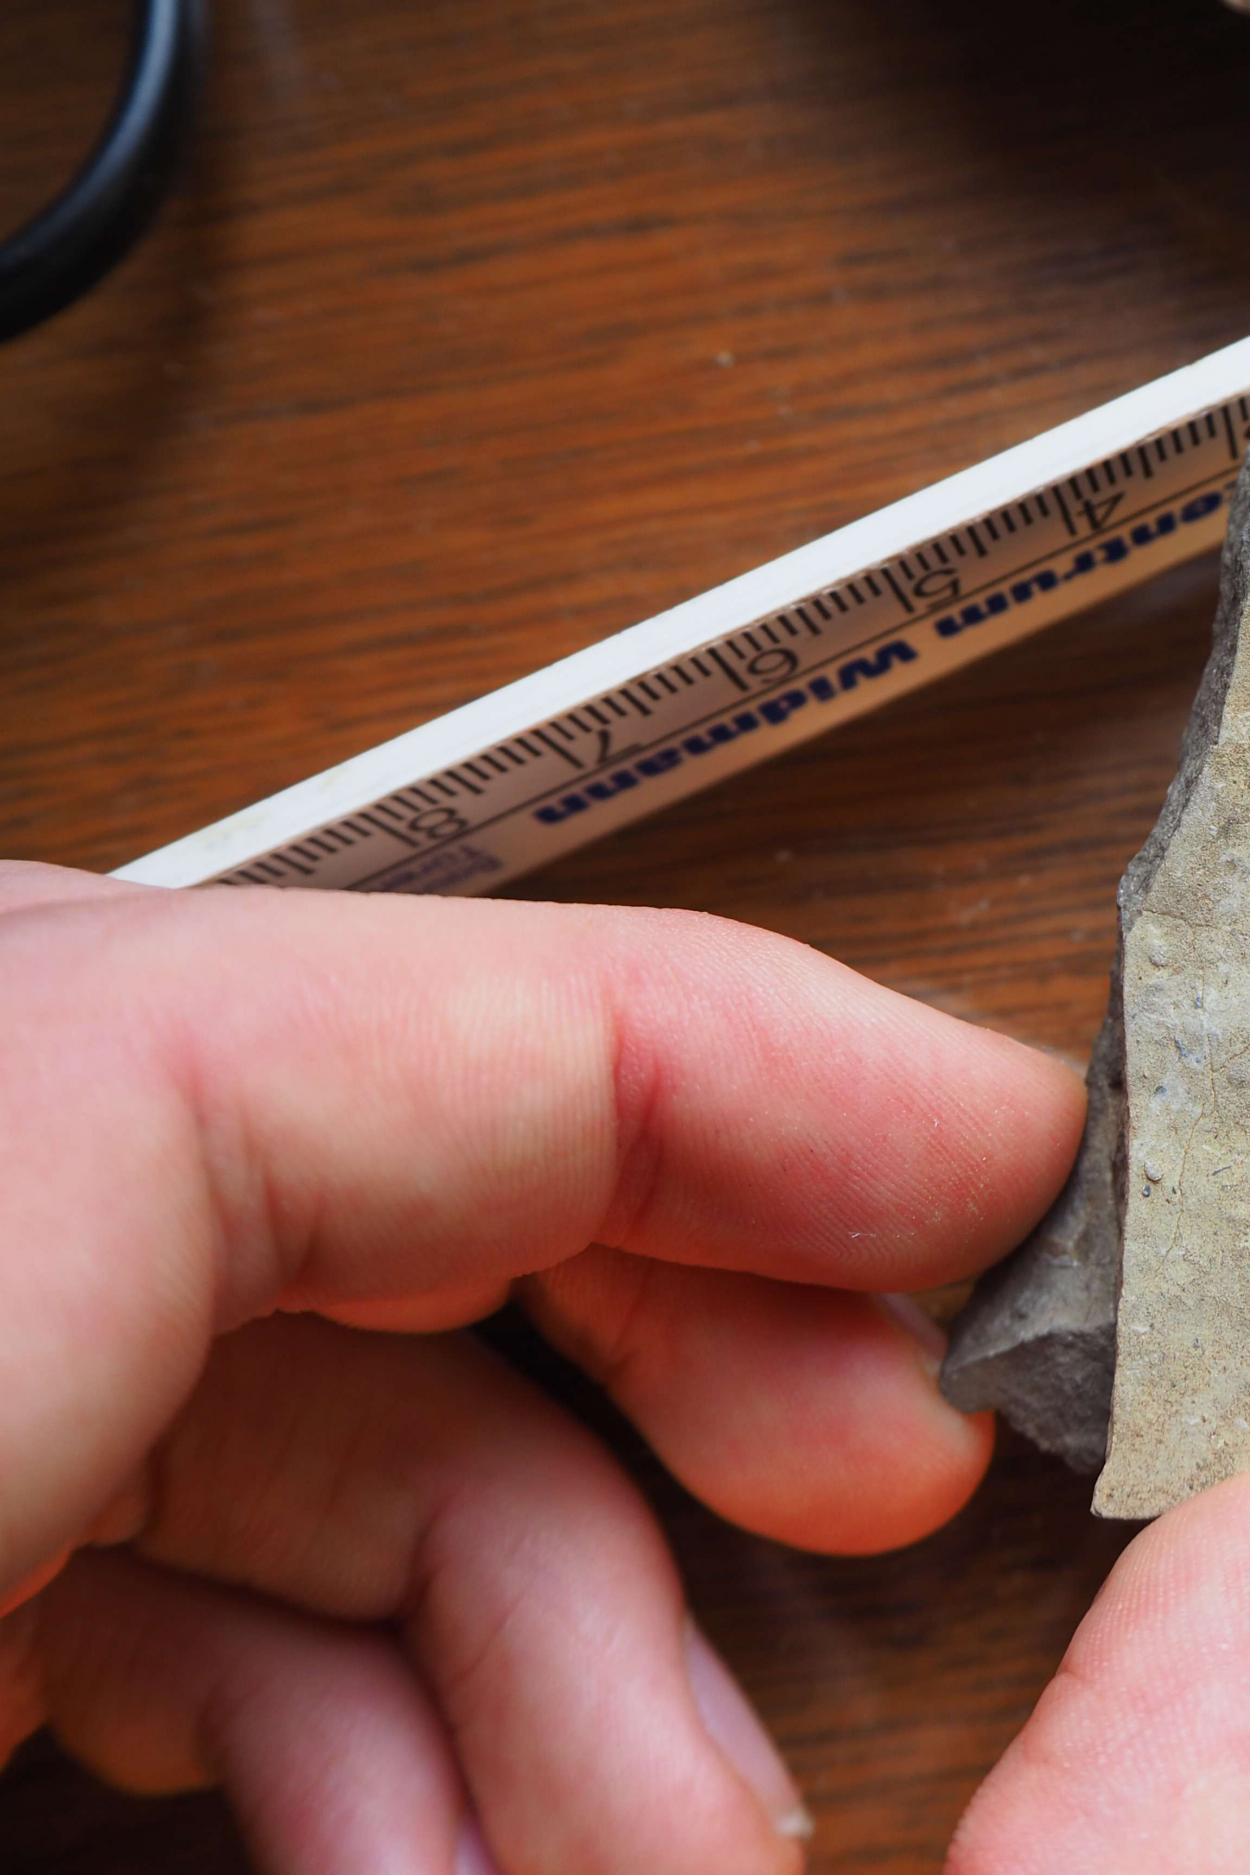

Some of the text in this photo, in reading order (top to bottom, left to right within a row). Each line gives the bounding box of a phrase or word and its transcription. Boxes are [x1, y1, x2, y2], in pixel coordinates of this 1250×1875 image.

[1077, 491, 1126, 532] 4
[913, 569, 962, 609] 5
[747, 649, 798, 684] 6
[533, 641, 919, 825] Widmann
[595, 730, 644, 764] 7
[410, 808, 469, 841] 8
